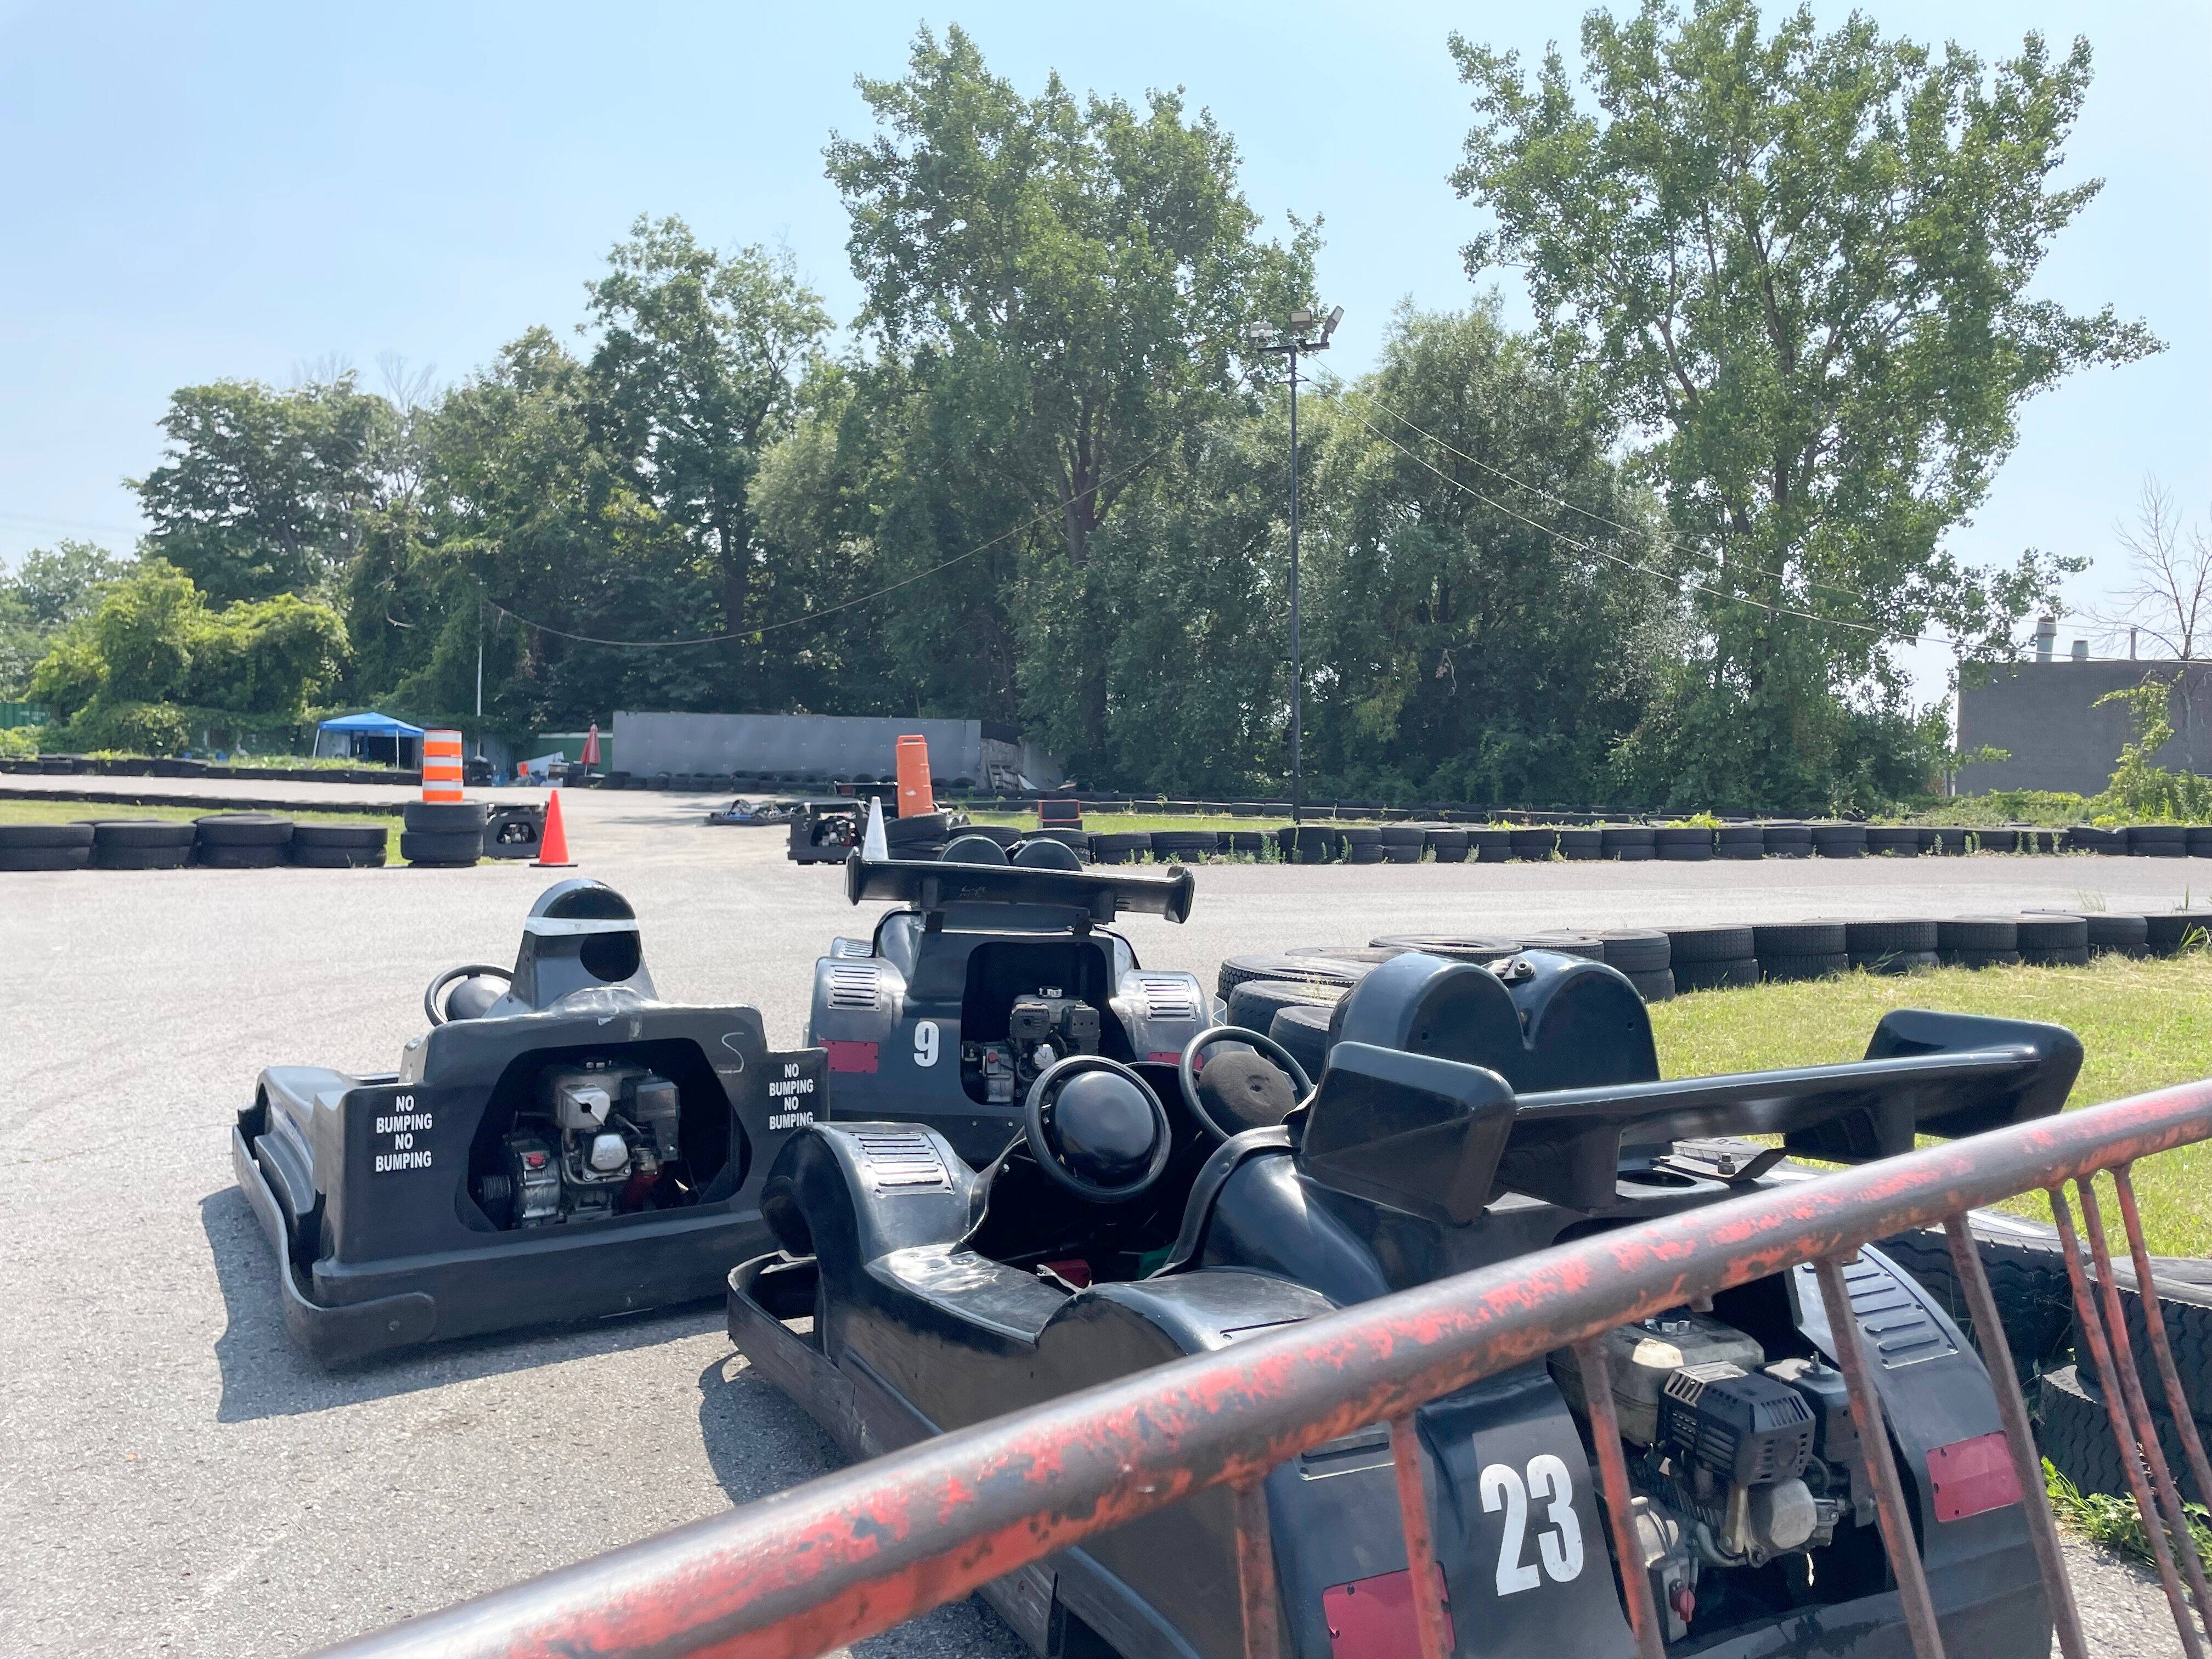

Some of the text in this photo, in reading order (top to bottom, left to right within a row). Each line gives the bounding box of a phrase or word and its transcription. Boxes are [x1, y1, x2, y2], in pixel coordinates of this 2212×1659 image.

[719, 1032, 745, 1074] S
[913, 1021, 939, 1067] 9
[785, 1063, 799, 1078] NO
[769, 1079, 814, 1097] BUMPING
[396, 1095, 414, 1112] NO
[784, 1096, 799, 1111] NO
[376, 1113, 432, 1133] BUMPING
[769, 1111, 814, 1130] BUMPING
[395, 1133, 413, 1150] NO
[375, 1150, 432, 1172] BUMPING
[1480, 1454, 1584, 1596] 23
